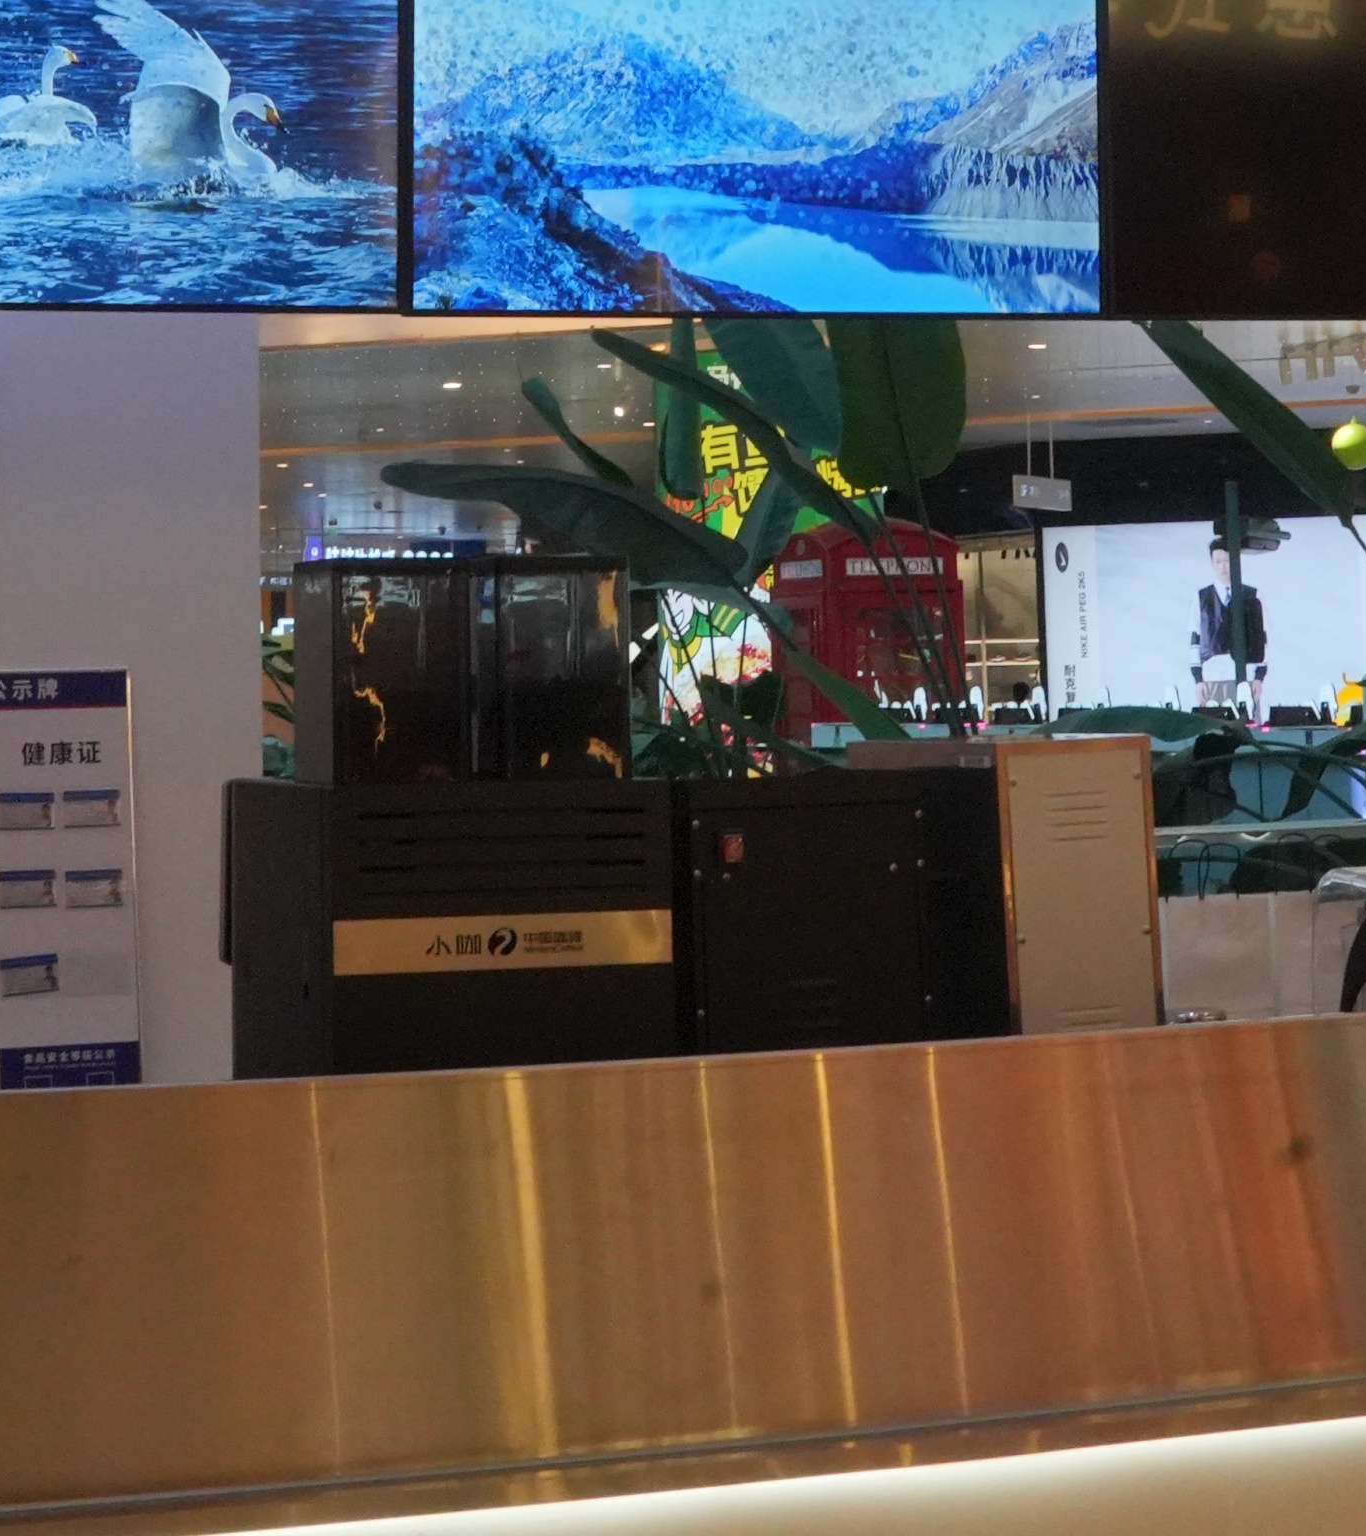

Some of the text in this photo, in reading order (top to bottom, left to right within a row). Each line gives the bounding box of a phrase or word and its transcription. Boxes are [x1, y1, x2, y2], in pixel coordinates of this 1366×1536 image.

[1078, 593, 1087, 613] PEG
[1079, 616, 1088, 632] AIR
[1081, 634, 1089, 659] NIKE
[21, 740, 102, 767] 健康证
